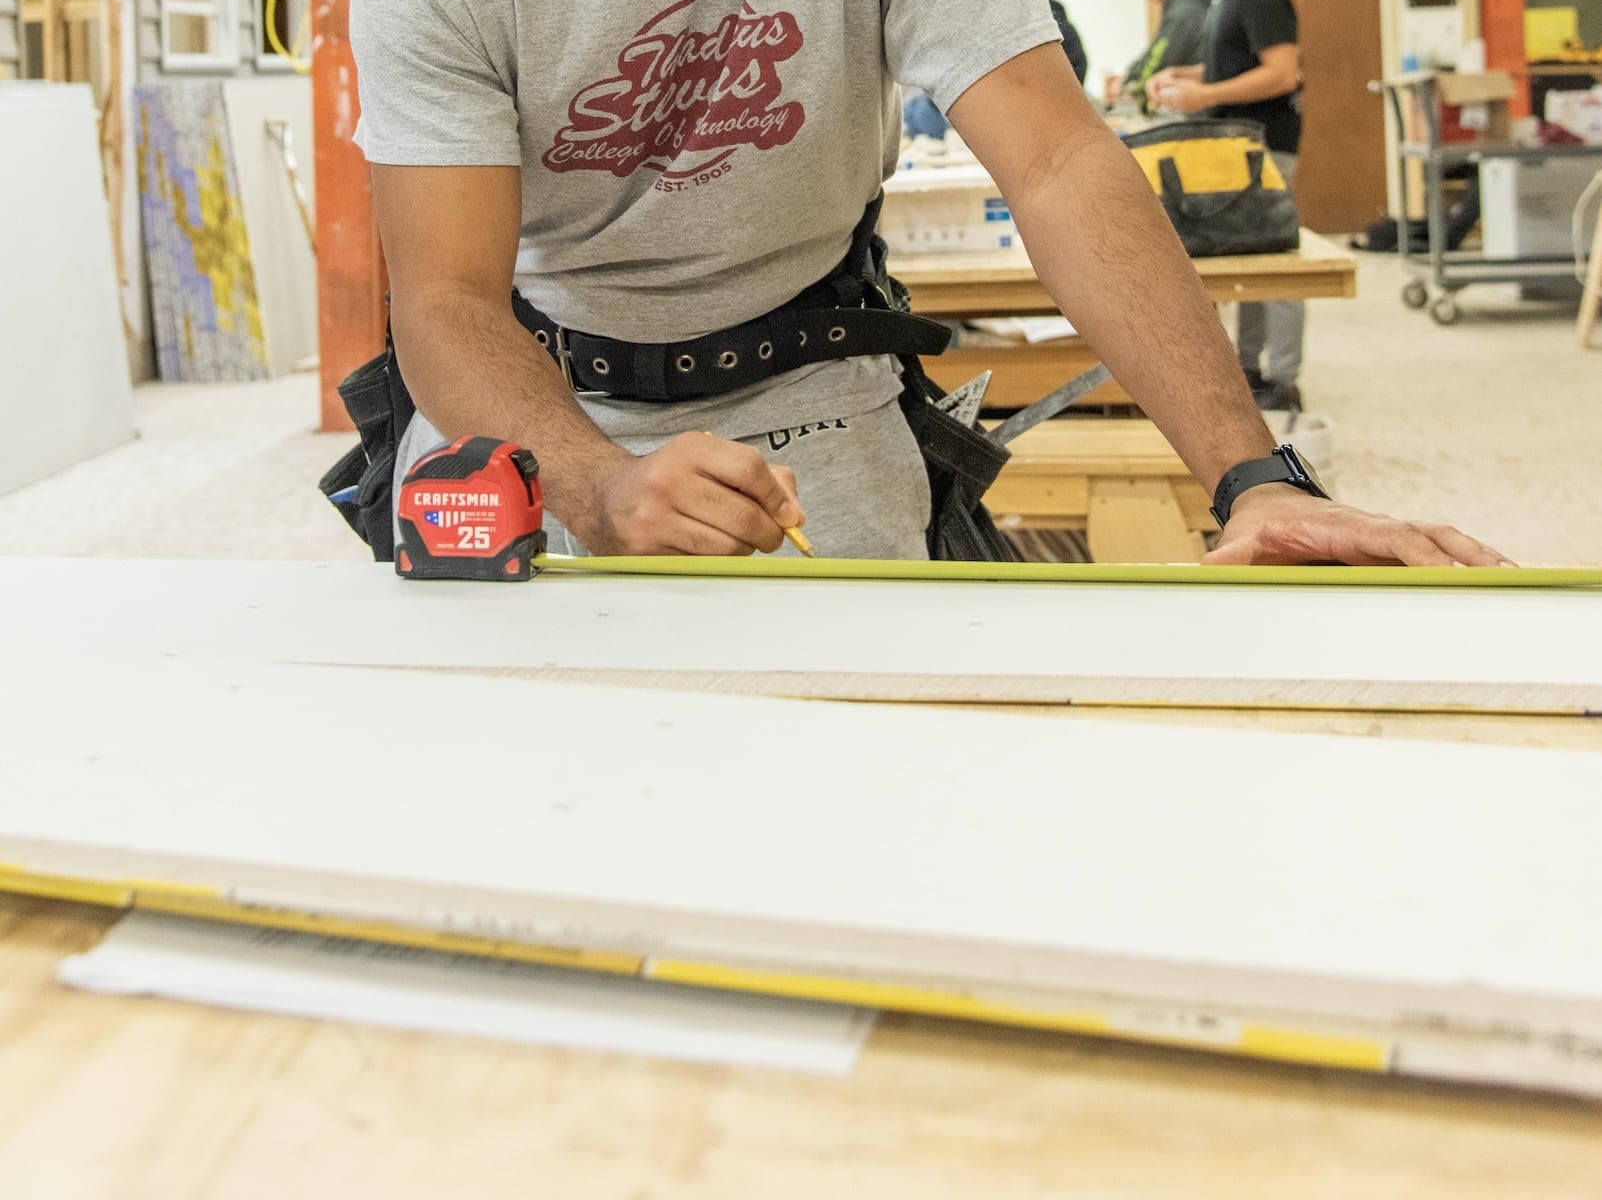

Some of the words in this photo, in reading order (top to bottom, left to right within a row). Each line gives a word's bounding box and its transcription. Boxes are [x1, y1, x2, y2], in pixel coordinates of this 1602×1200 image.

[547, 141, 645, 167] College
[654, 117, 686, 149] Of
[654, 178, 688, 193] EST.
[692, 162, 733, 187] 1905
[413, 492, 499, 506] CRAFTSMAN
[457, 526, 490, 549] 25
